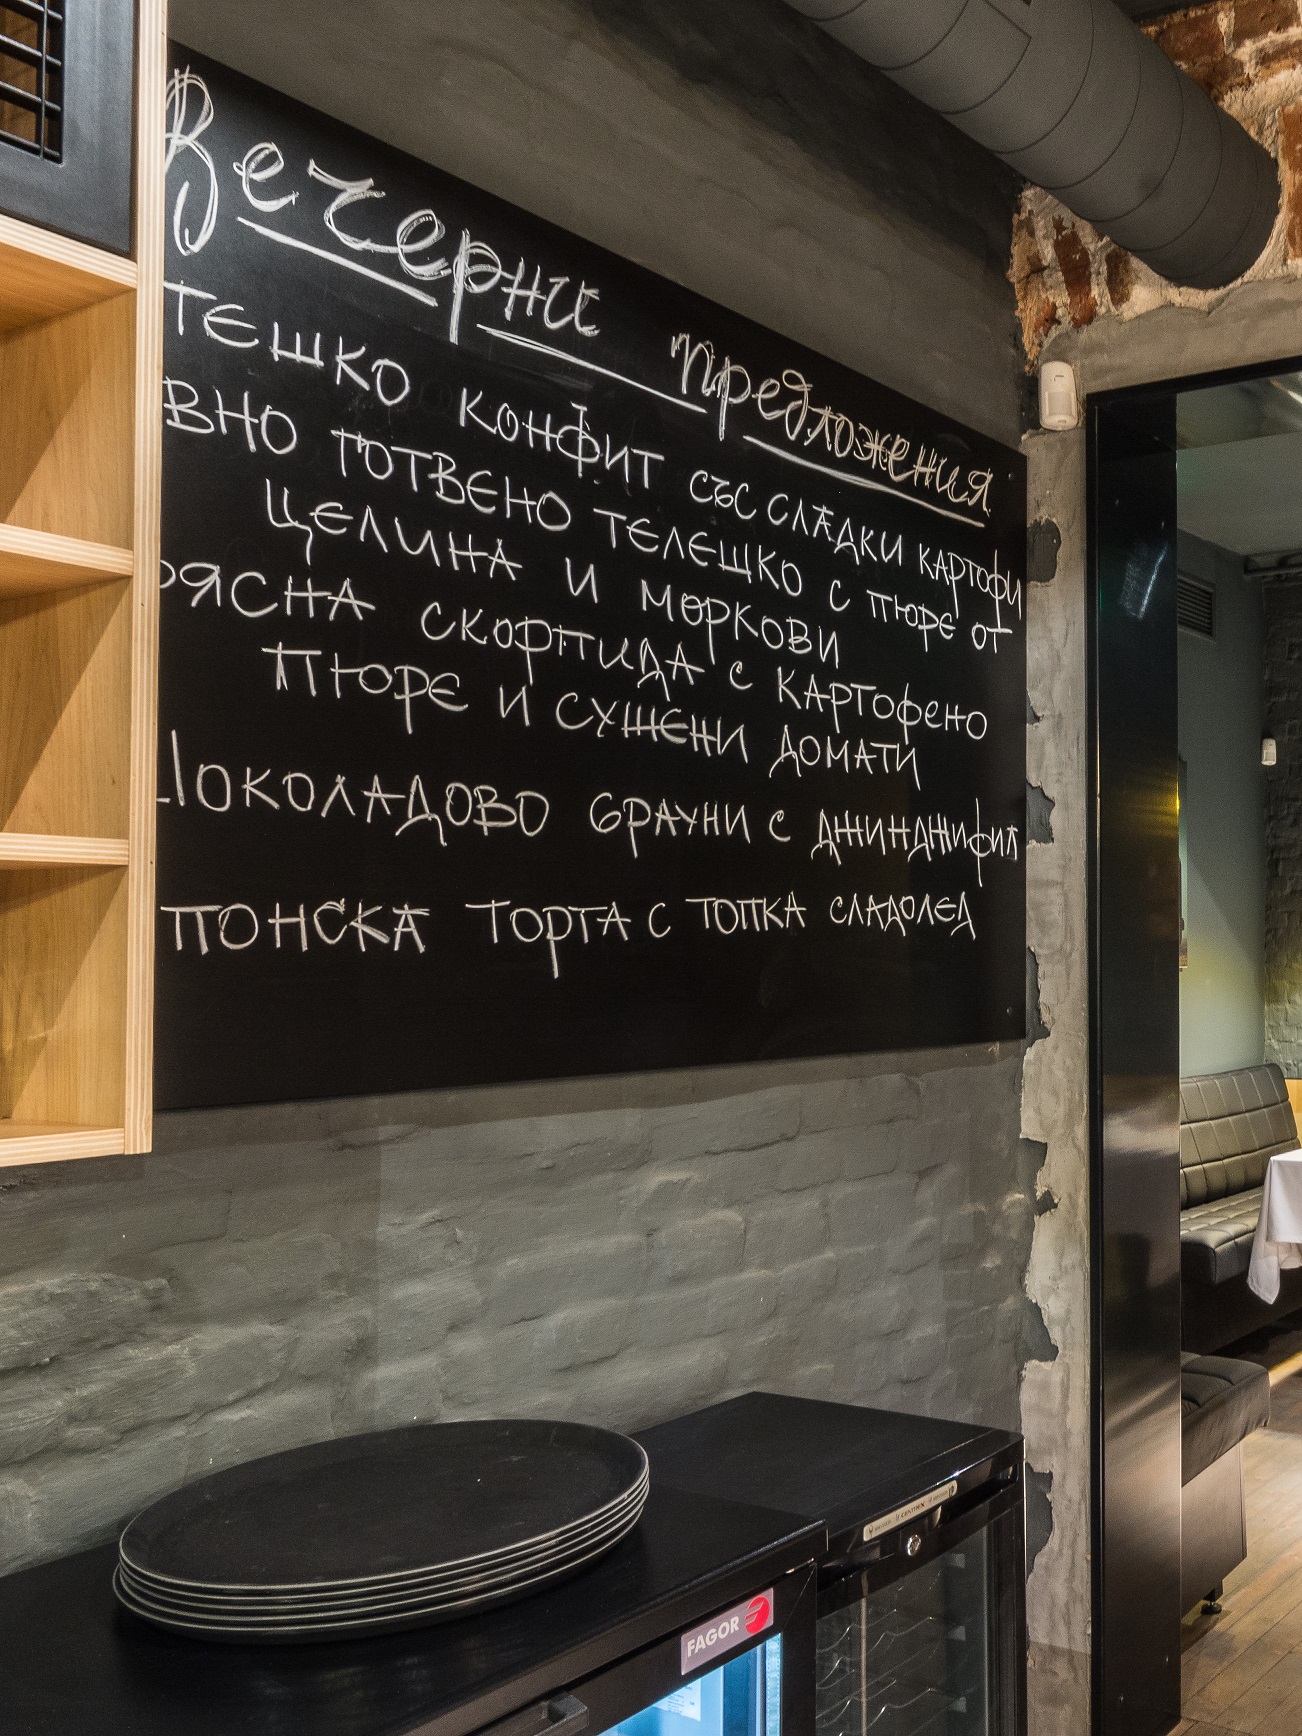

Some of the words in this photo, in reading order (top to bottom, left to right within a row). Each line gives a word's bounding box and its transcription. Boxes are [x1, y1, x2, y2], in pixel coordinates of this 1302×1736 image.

[163, 280, 410, 406] ТЕШКО
[459, 387, 665, 489] КОНФИТ
[690, 470, 757, 520] СЪС
[768, 494, 903, 567] СЛАДКИ
[919, 543, 1022, 631] КАРТОФИ
[163, 376, 298, 455] ВНО
[593, 507, 802, 597] ТЕЛЕШКО
[866, 589, 956, 652] ПЮРЕ
[972, 622, 1013, 654] ОТ
[160, 559, 376, 621] ЯСНА
[421, 601, 706, 702] СКОРПИДА
[265, 478, 523, 581] ЦЕЛИНА
[566, 557, 598, 604] И
[641, 579, 839, 669] МОРКОВИ
[261, 641, 469, 734] ПЮРЕ
[499, 684, 530, 727] И
[769, 724, 921, 791] ДОМАТИ
[811, 797, 1018, 887] ДЖИНДЖИФИЛ
[160, 898, 430, 955] ПОНСКА
[465, 899, 632, 979] ТОРТА
[685, 890, 807, 935] ТОПКА
[829, 891, 976, 940] СЛАДОЛЕД
[686, 1614, 740, 1658] FAGOR
